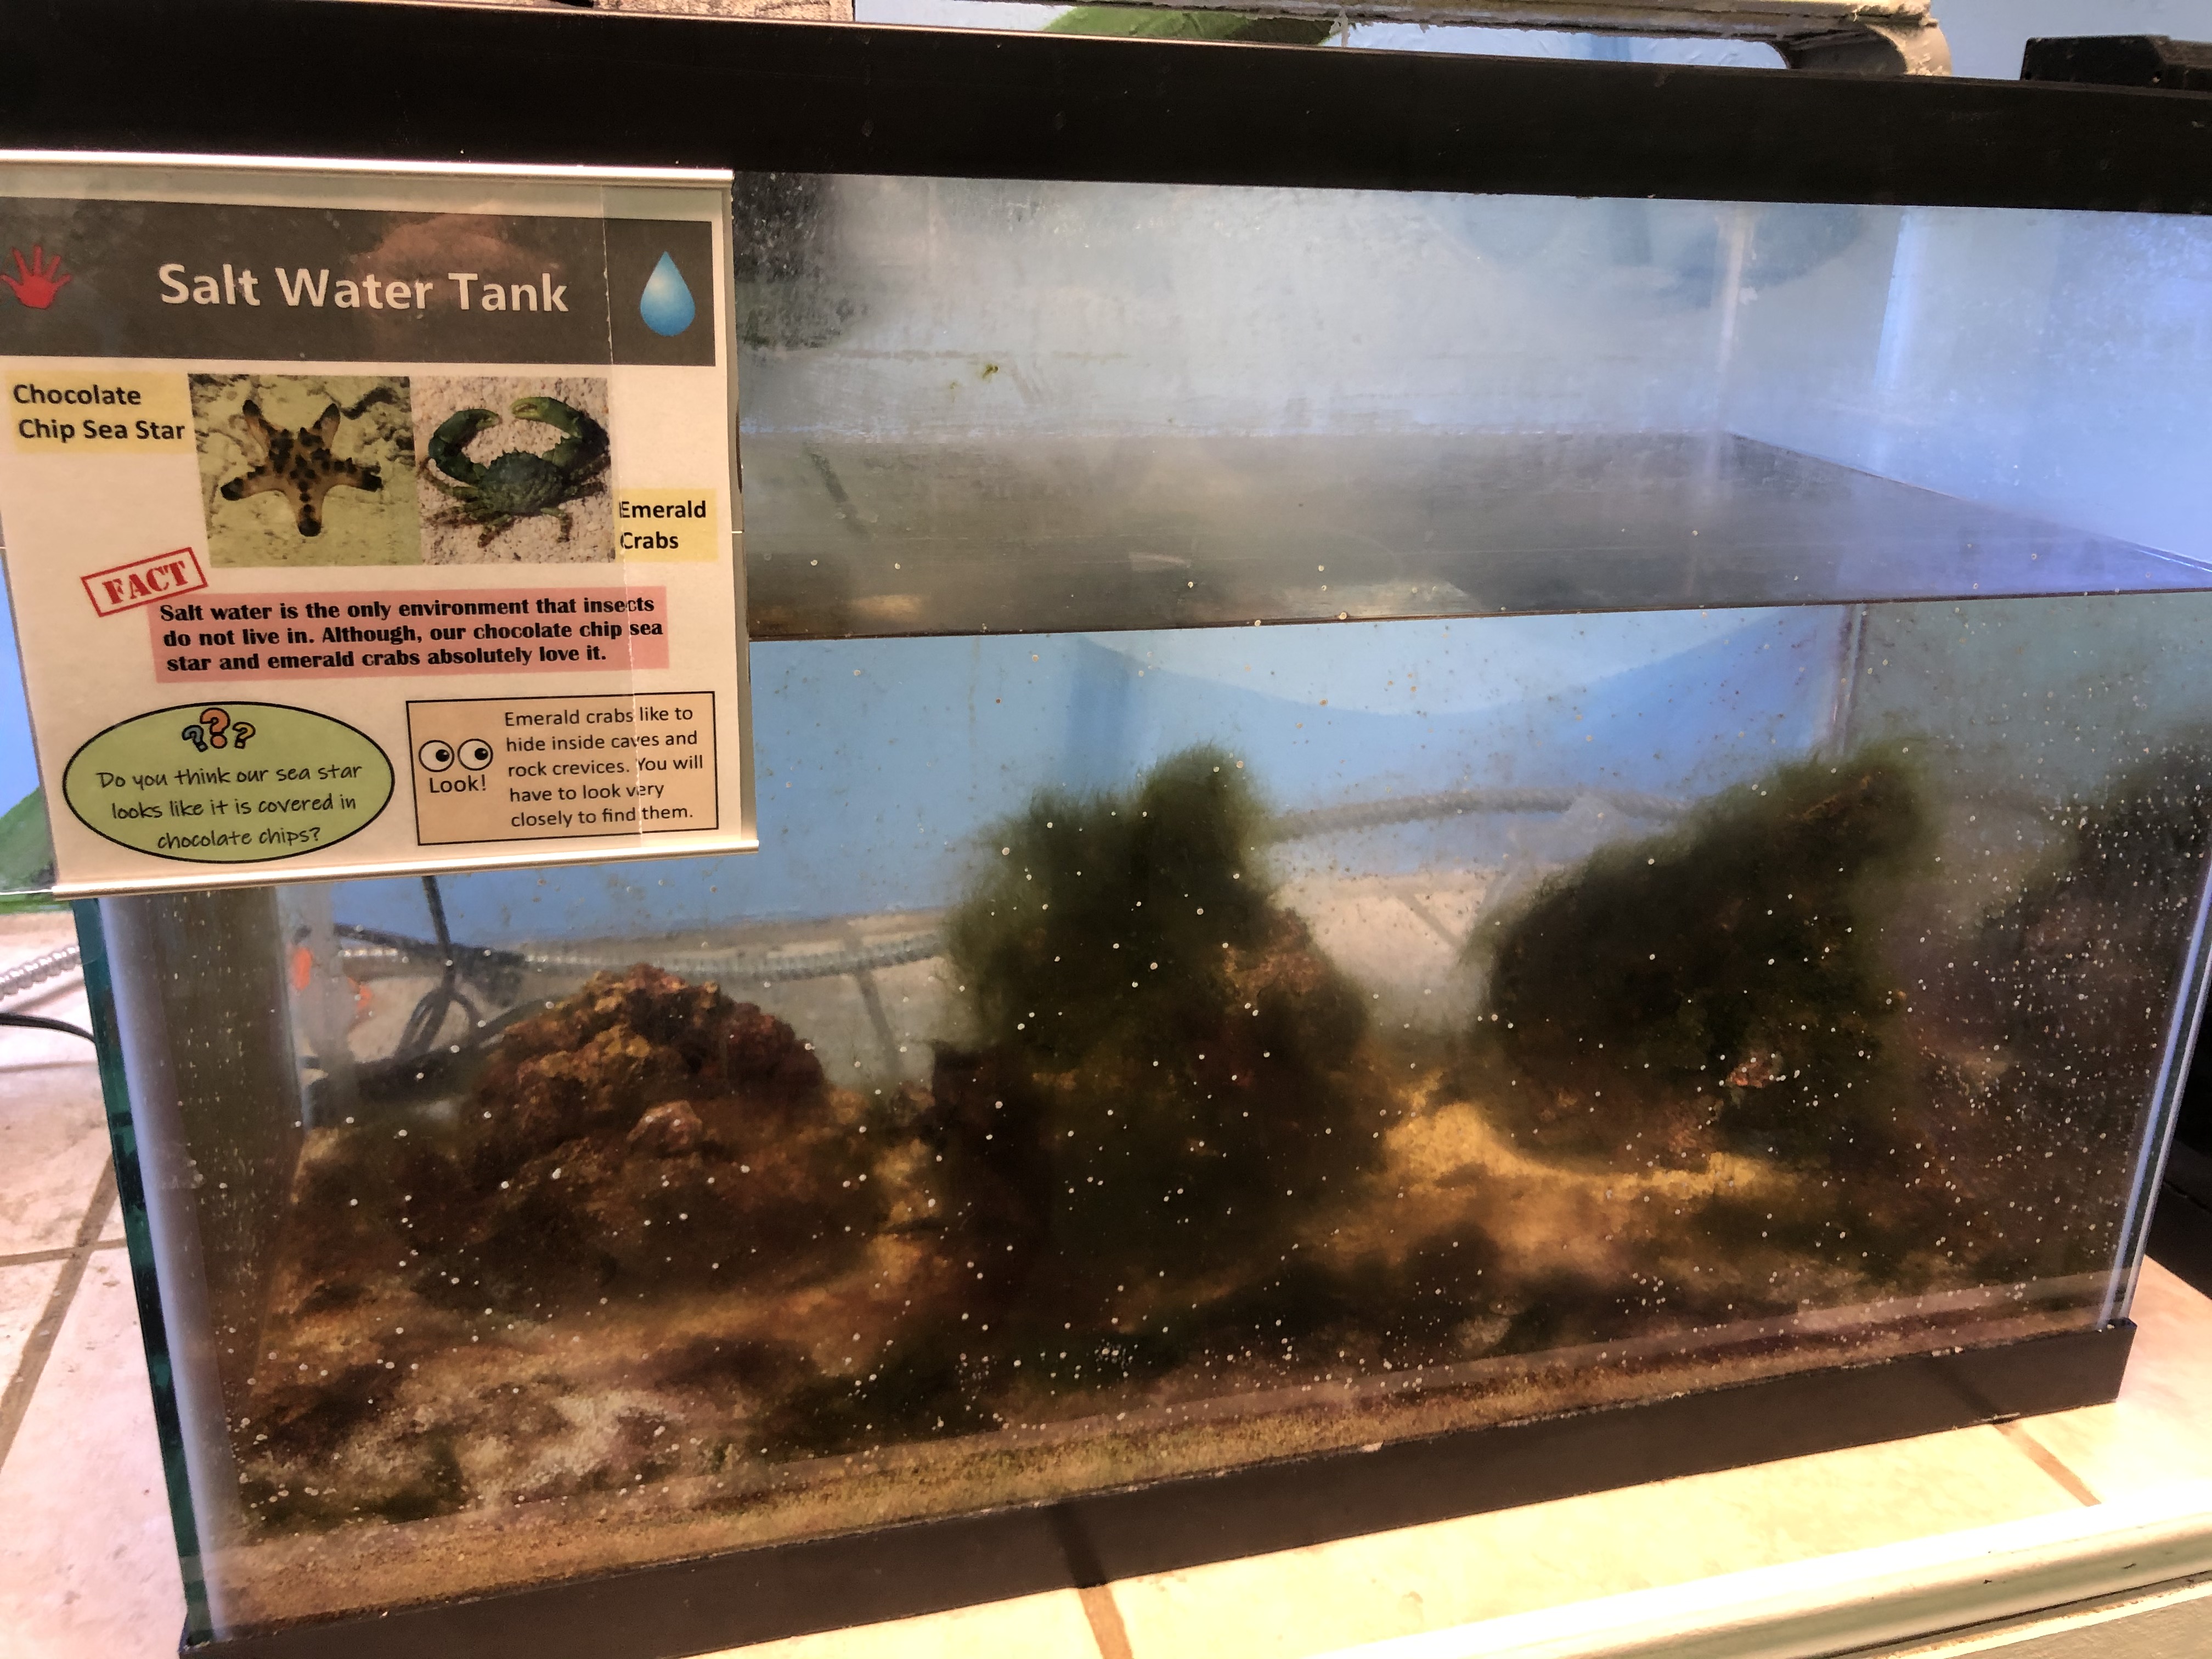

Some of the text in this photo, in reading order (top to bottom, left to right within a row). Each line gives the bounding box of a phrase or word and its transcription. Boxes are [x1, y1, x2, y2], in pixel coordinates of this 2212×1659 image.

[159, 263, 569, 312] Salt Water Tank
[14, 383, 142, 405] Chocolate
[19, 418, 186, 443] Chip Sea Star
[619, 500, 707, 519] Emerald
[620, 531, 679, 550] Crabs
[102, 560, 190, 605] FACT
[160, 596, 654, 621] Salt water is the only environment that insects
[163, 620, 663, 647] do not live in. Although, our chocolate chip sea
[167, 644, 606, 672] star and emerald crabs absolutely love it.
[505, 706, 693, 727] Emerald crabs like to
[506, 731, 697, 752] hide inside caves and
[508, 754, 703, 777] rock crevices. You will
[96, 765, 362, 791] Do you think our sea star
[428, 775, 487, 794] Look!
[510, 782, 665, 802] have to look very
[111, 794, 357, 820] looks like it is covered in
[511, 805, 693, 827] closely to find them.
[157, 827, 321, 849] chocolate chips?
